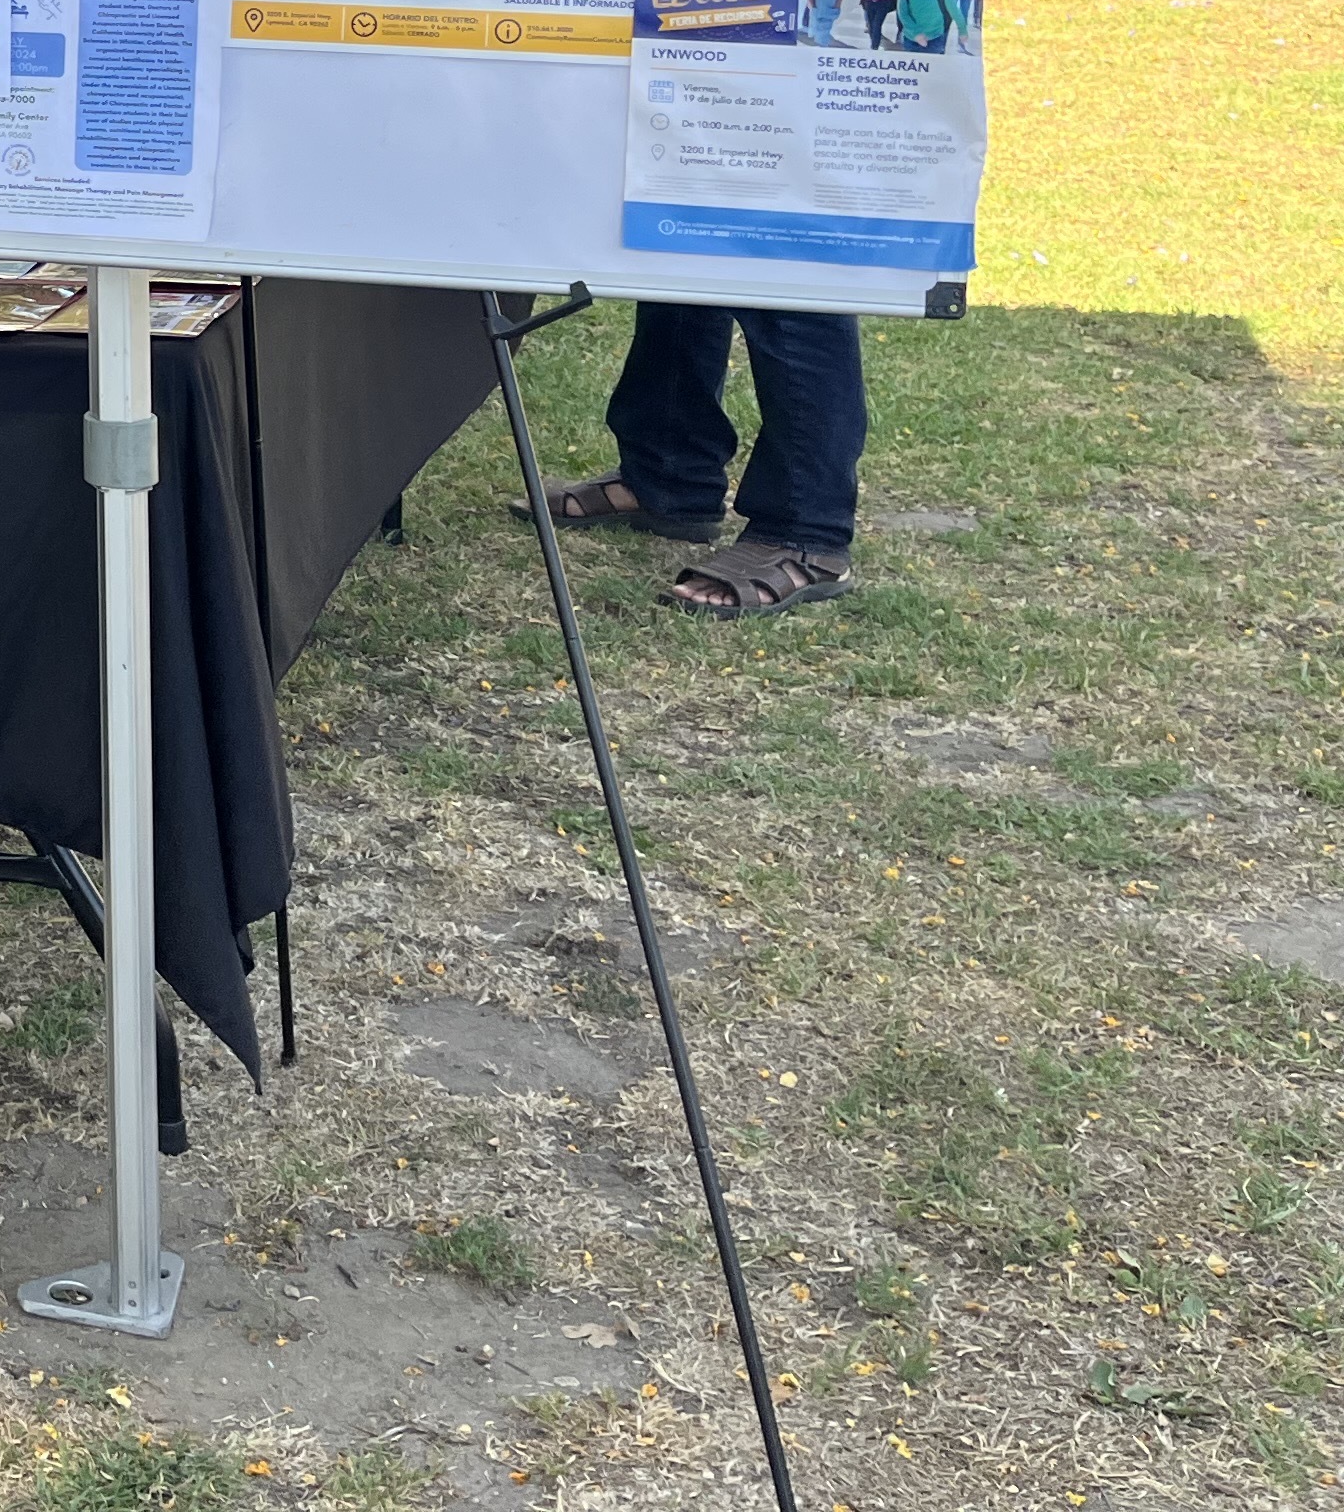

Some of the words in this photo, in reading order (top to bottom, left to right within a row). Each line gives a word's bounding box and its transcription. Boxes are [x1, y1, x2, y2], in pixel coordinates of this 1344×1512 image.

[669, 14, 698, 27] FERIA
[700, 13, 712, 25] DE
[714, 9, 765, 24] RECURSOS
[651, 48, 727, 62] LYNWOOD
[817, 56, 834, 68] SE
[839, 57, 929, 73] REGALARÁN
[817, 71, 852, 83] útiles
[856, 73, 918, 86] escolares
[683, 94, 694, 102] 19
[698, 95, 710, 104] de
[712, 95, 732, 106] julio
[735, 97, 747, 105] de
[750, 98, 774, 106] 2024
[816, 87, 824, 97] y
[828, 86, 885, 99] mochilas
[889, 91, 920, 102] para
[18, 112, 49, 121] Center
[682, 120, 694, 128] De
[698, 120, 722, 130] 10:00
[752, 123, 772, 133] 2:00
[728, 158, 743, 167] CA
